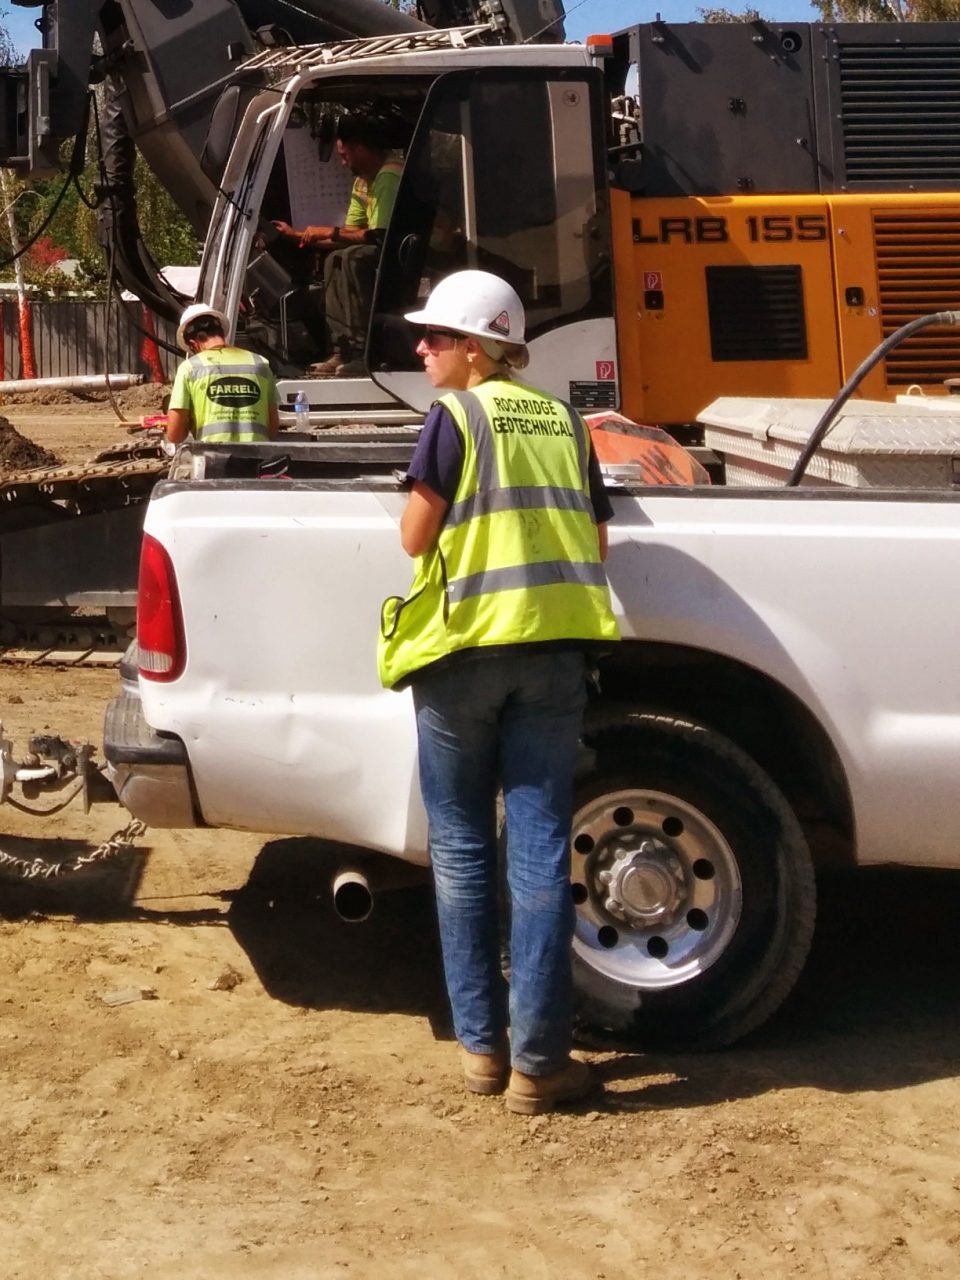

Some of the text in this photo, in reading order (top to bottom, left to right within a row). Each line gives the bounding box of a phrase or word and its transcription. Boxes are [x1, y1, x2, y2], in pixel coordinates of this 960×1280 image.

[746, 215, 828, 242] 155
[209, 384, 259, 395] FARRELL
[493, 397, 557, 416] ROCKRIDGE
[492, 416, 574, 437] GEOTECHNICAL
